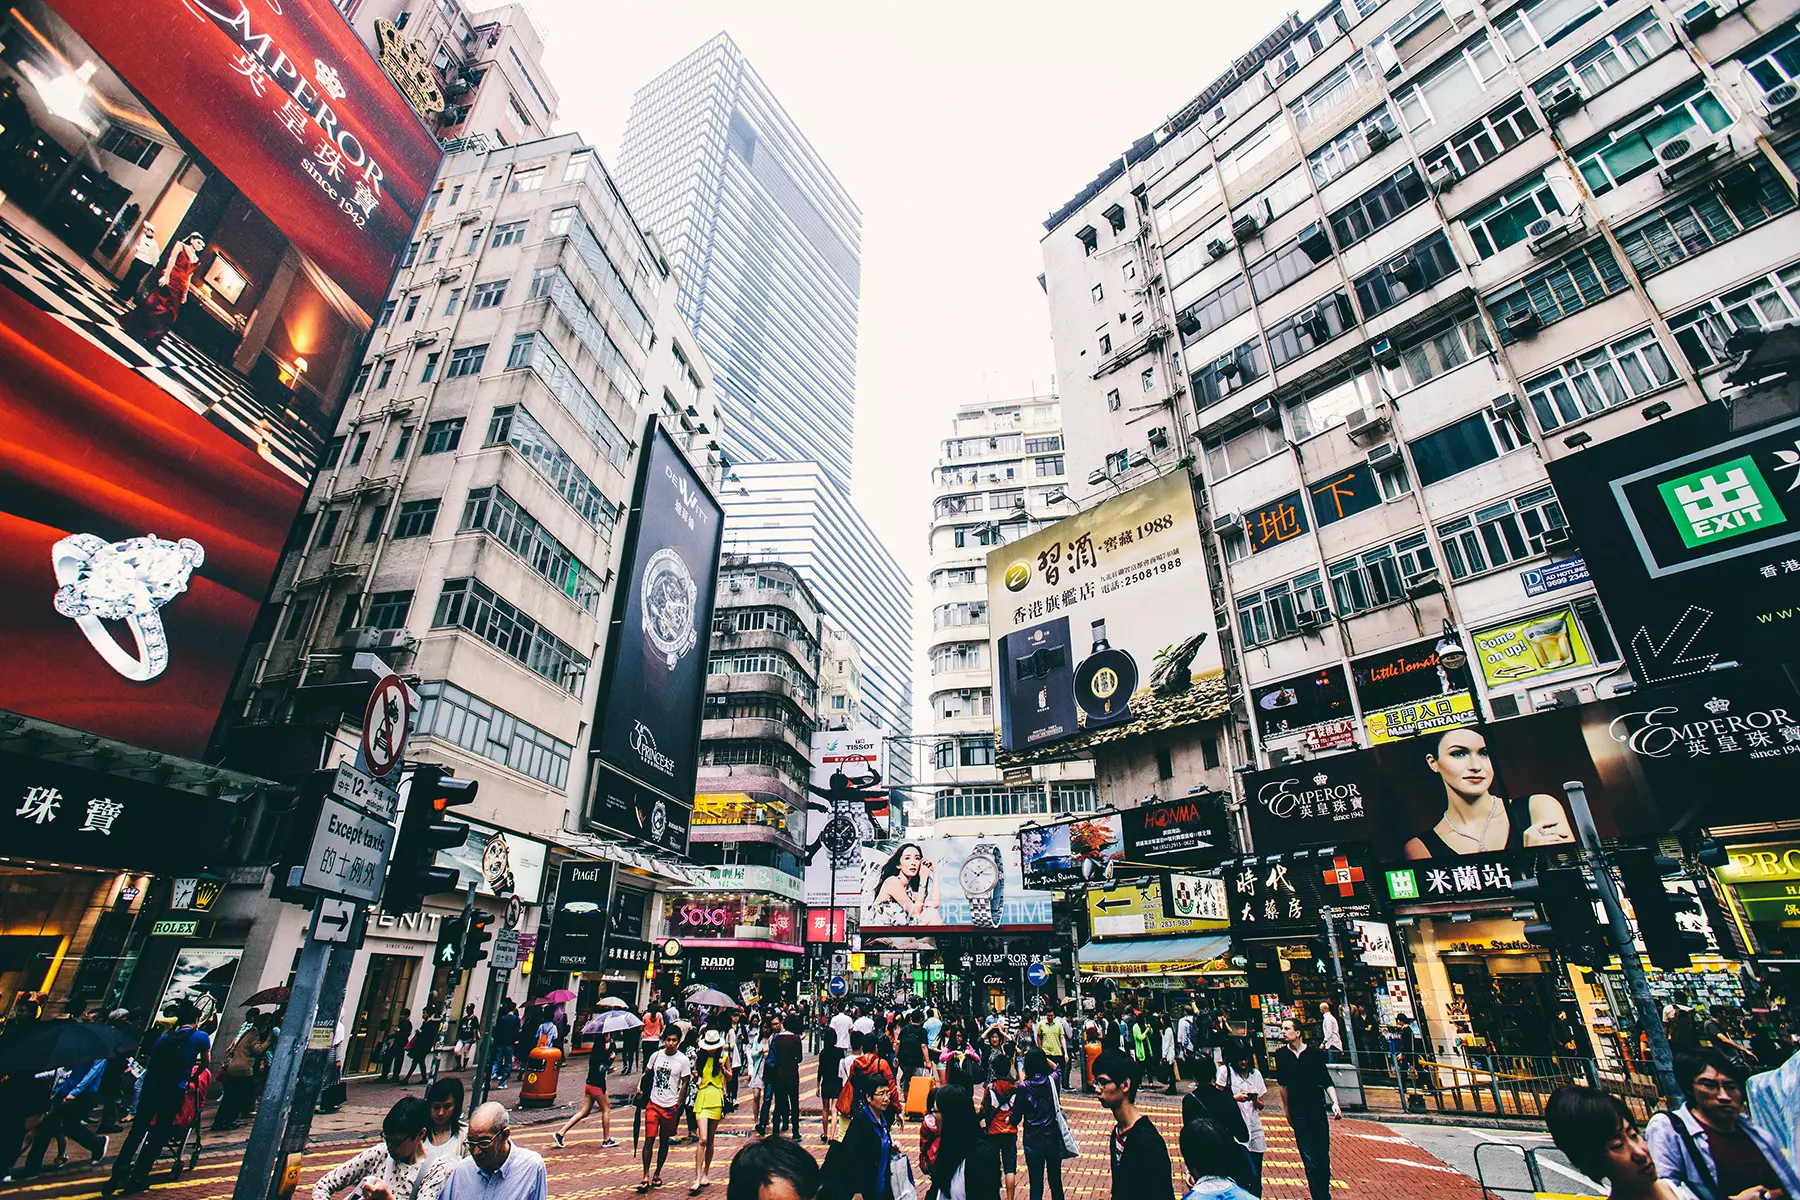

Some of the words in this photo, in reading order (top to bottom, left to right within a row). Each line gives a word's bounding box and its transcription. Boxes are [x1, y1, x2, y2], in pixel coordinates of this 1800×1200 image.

[229, 44, 380, 219] 英皇珠寶
[300, 158, 338, 200] since
[338, 197, 366, 230] 1942
[1673, 468, 1760, 523] 出
[1136, 514, 1174, 540] 1988
[1690, 503, 1763, 539] EXIT
[1557, 566, 1587, 578] HOTLINE
[1568, 571, 1590, 581] 2348
[1757, 606, 1800, 624] ww
[1480, 630, 1516, 651] Come
[1487, 654, 1504, 664] on
[1505, 640, 1527, 657] up!
[1385, 700, 1453, 727] 正門入口
[1387, 723, 1416, 737] MAIN
[1417, 710, 1476, 731] ENTRANCE
[1609, 706, 1796, 758] EMPEROR
[1684, 724, 1800, 758] 英皇珠寶
[1749, 747, 1781, 760] since
[1258, 778, 1361, 818] EMPEROR
[1300, 796, 1364, 820] 英皇珠寶
[16, 786, 125, 836] 珠寶
[1144, 803, 1200, 828] HONMA
[1333, 811, 1350, 821] since
[1350, 810, 1364, 820] 1942
[327, 814, 363, 845] Except
[362, 828, 386, 853] taxis
[320, 846, 377, 887] 的士例外
[572, 868, 601, 881] PIAGET
[1425, 863, 1512, 894] 米蘭站
[1236, 863, 1296, 897] 時代
[1241, 897, 1302, 921] 大藥房
[153, 921, 196, 935] ROLEX
[1161, 920, 1175, 928] 2831
[701, 957, 735, 967] RADO
[765, 959, 778, 969] RADO
